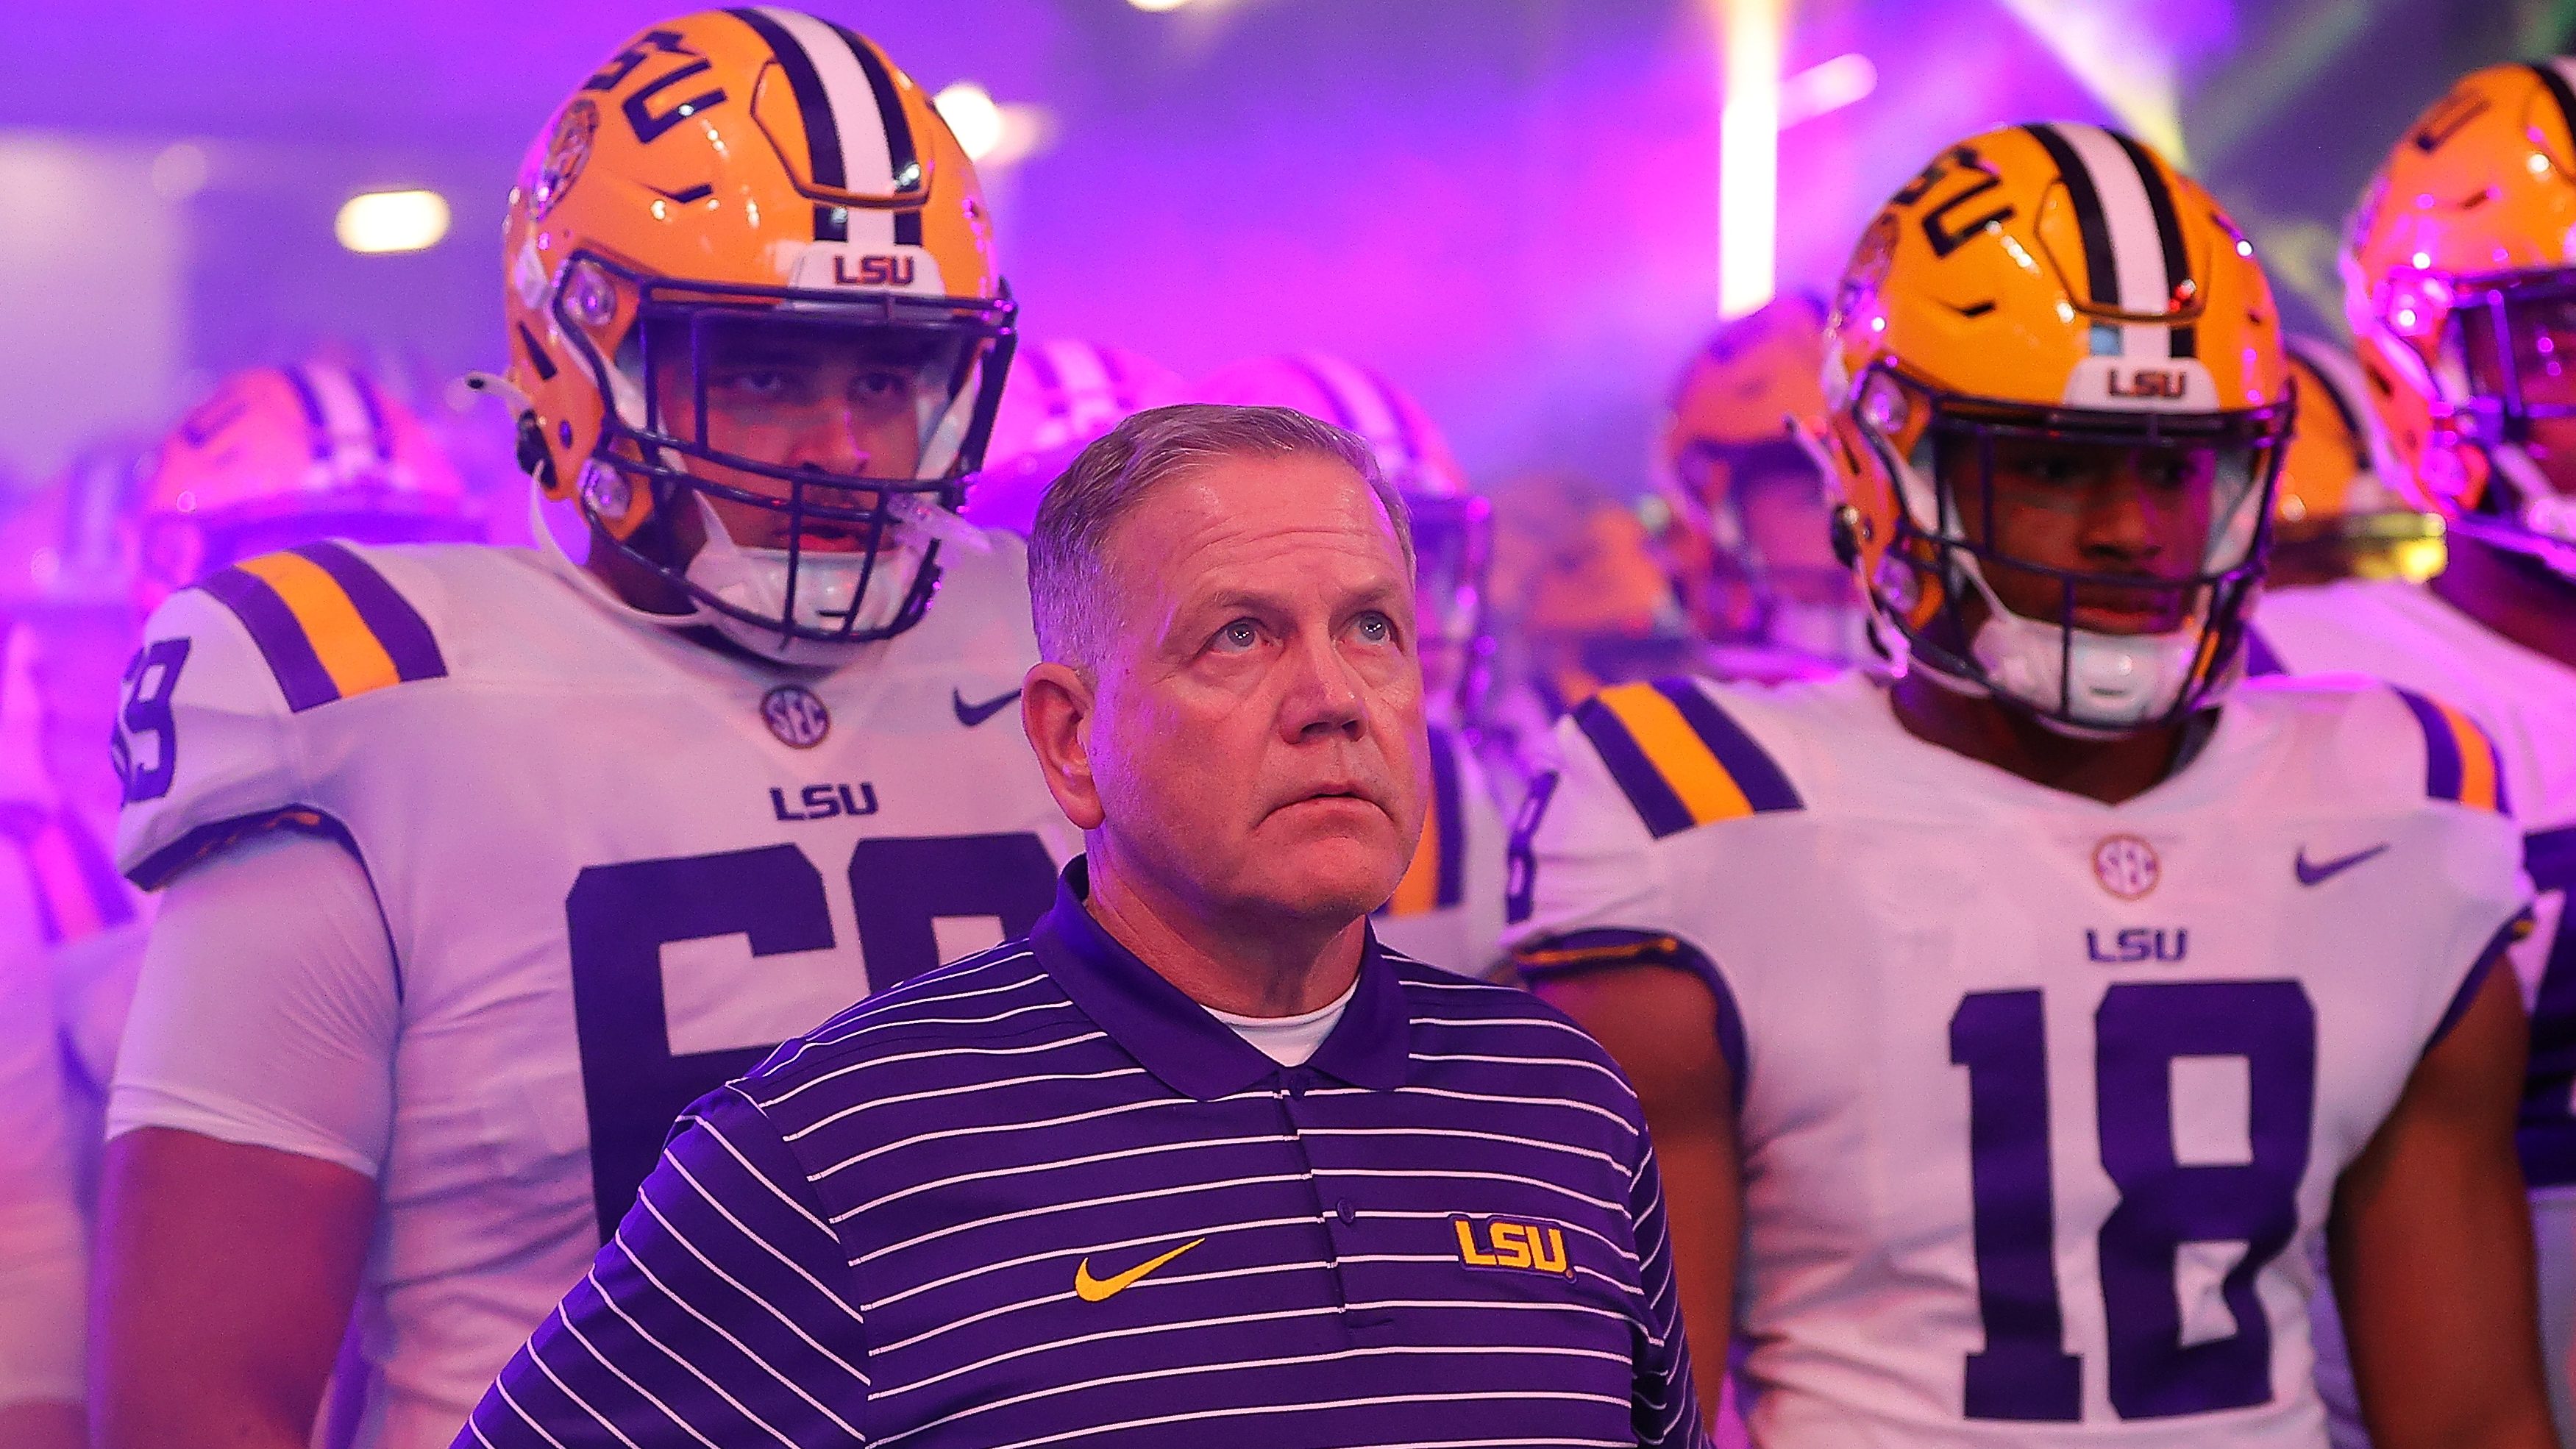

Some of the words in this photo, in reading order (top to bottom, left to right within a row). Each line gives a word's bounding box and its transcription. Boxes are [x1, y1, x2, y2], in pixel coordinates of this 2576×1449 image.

[834, 254, 914, 285] LSU
[2108, 369, 2186, 399] LSU
[769, 782, 879, 821] LSU
[2085, 928, 2188, 963] LSU
[1949, 980, 2316, 1422] 18
[1453, 1220, 1568, 1273] LSU
